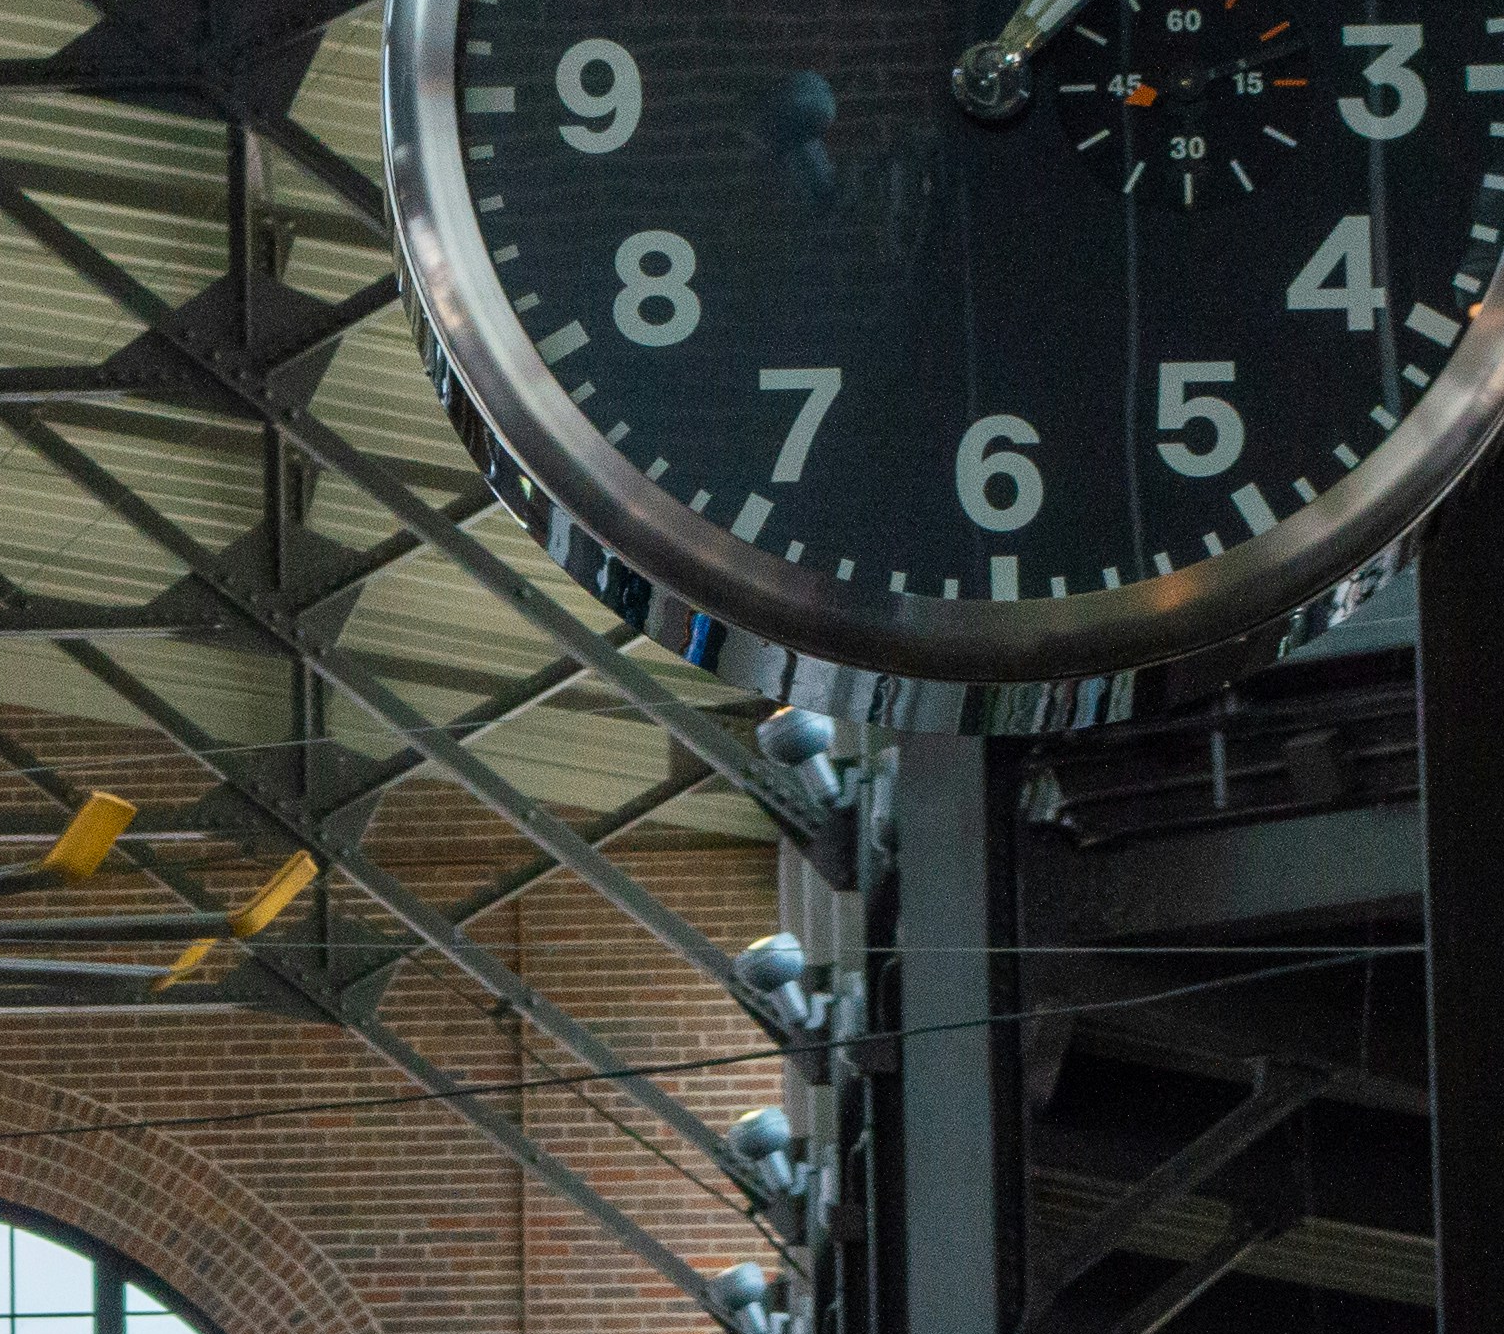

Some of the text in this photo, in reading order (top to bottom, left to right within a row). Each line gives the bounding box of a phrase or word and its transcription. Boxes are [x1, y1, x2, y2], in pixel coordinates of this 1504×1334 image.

[1166, 8, 1202, 33] 60
[554, 37, 644, 154] 9
[1107, 73, 1142, 97] 45
[1232, 70, 1264, 95] 15
[1337, 23, 1428, 141] 3
[1169, 135, 1206, 160] 30
[611, 229, 702, 348] 8
[1286, 215, 1388, 332] 4
[758, 366, 843, 484] 7
[955, 413, 1045, 533] 6
[1156, 360, 1245, 478] 5
